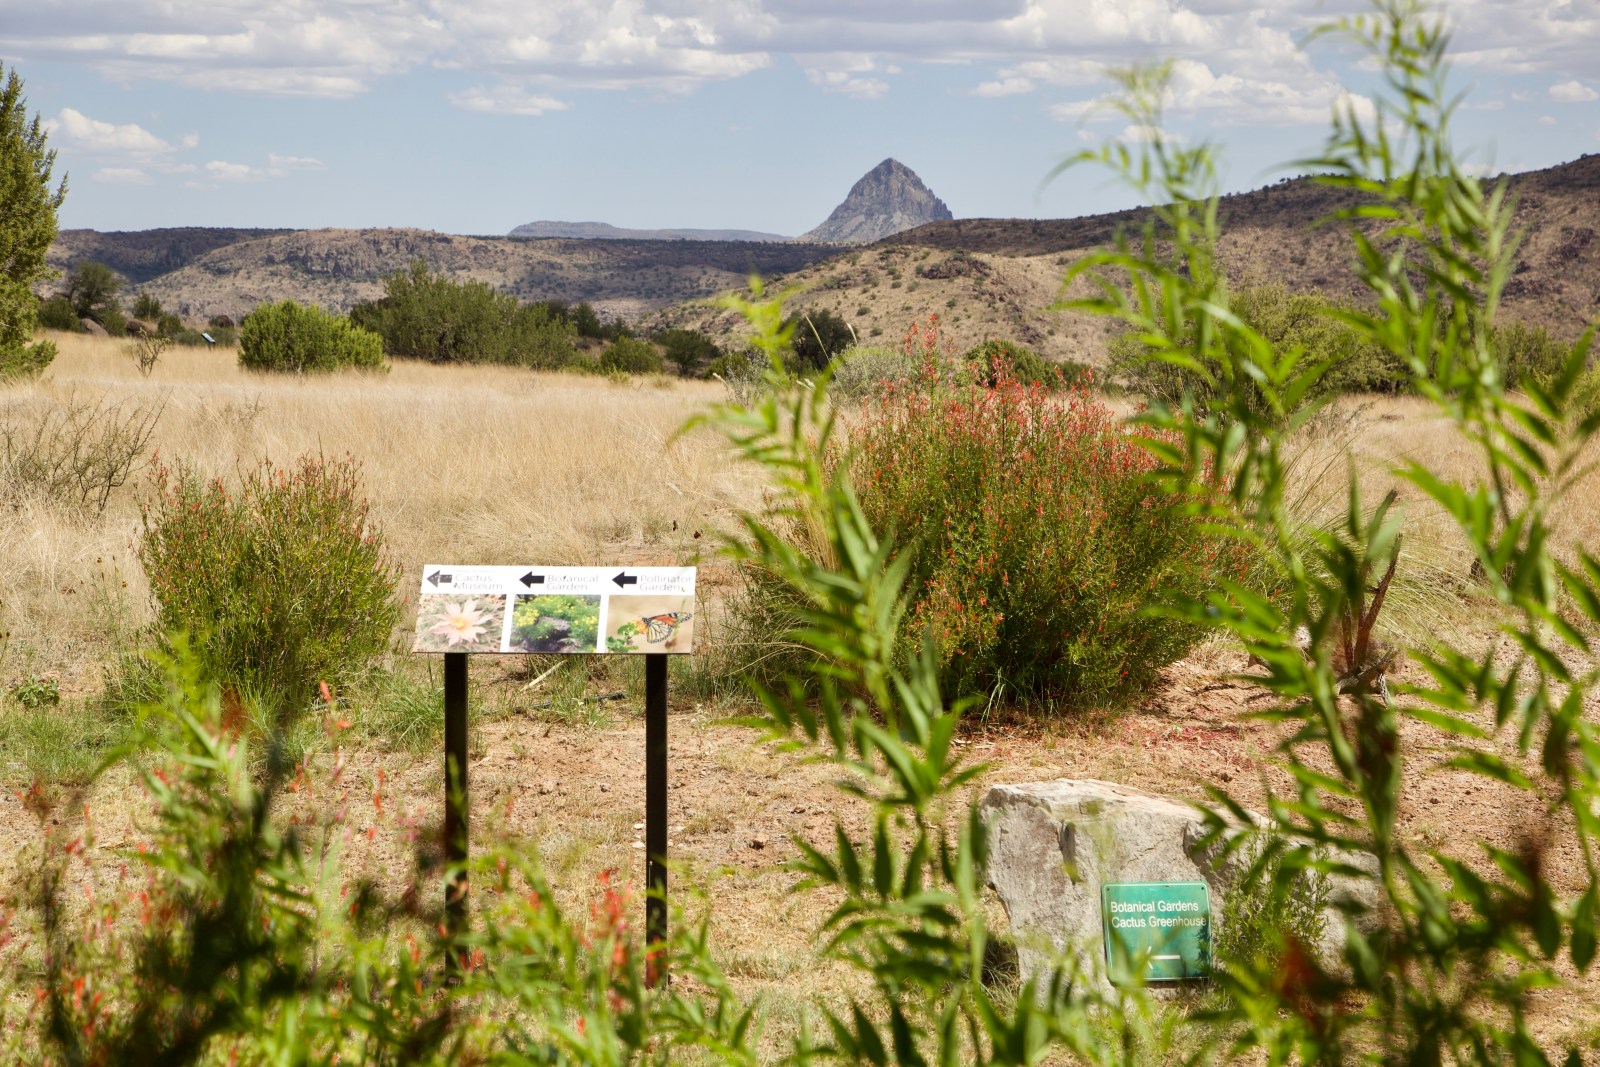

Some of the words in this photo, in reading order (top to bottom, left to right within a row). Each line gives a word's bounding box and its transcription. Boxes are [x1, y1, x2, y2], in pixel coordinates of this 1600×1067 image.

[454, 573, 493, 582] Cactus
[547, 574, 599, 583] Botanical
[640, 575, 693, 583] Pollinator
[453, 582, 503, 590] Museum
[546, 582, 588, 591] Garden
[639, 583, 681, 591] Garden
[1110, 901, 1156, 913] Botanical
[1157, 900, 1199, 912] Gardens
[1111, 916, 1147, 928] Cactus
[1148, 916, 1207, 927] Greenhouse
